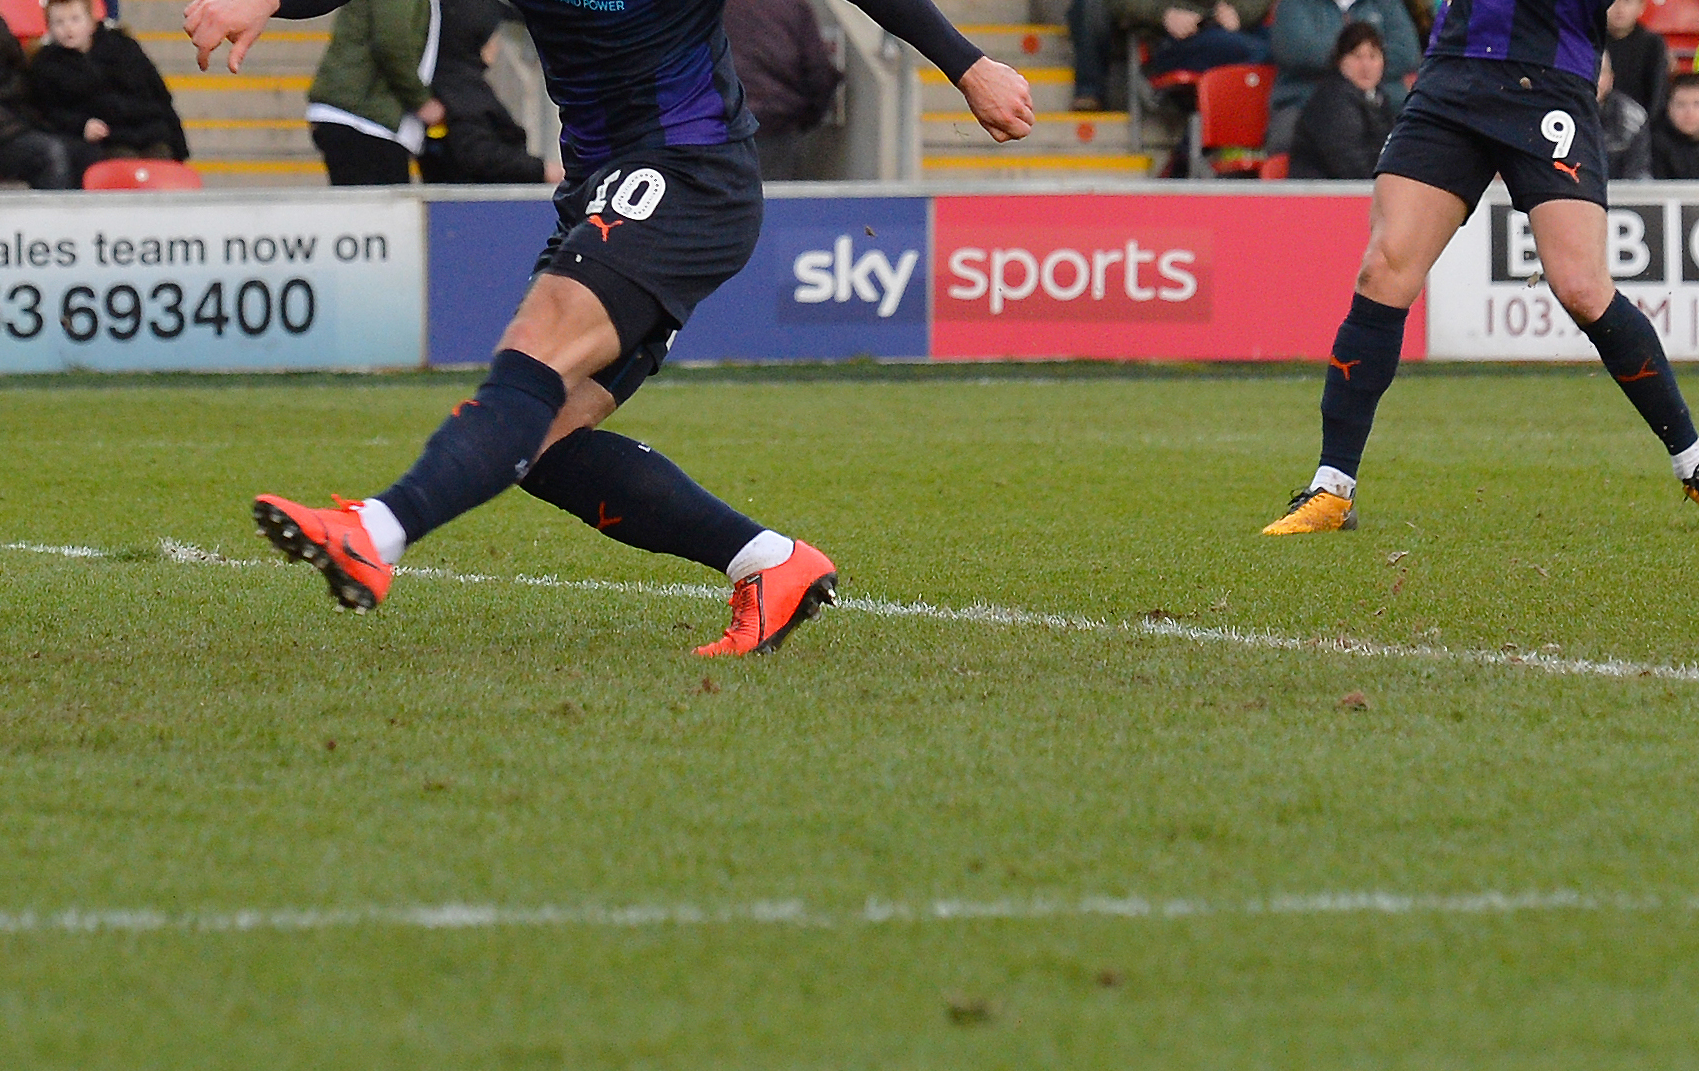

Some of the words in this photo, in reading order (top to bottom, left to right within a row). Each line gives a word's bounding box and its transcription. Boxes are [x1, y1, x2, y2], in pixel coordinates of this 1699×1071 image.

[1541, 110, 1576, 159] 9
[585, 168, 666, 221] 10
[95, 233, 205, 265] team
[225, 235, 316, 263] now
[334, 234, 388, 262] on
[793, 235, 919, 317] sky
[948, 240, 1198, 315] sports
[60, 278, 316, 342] 693400
